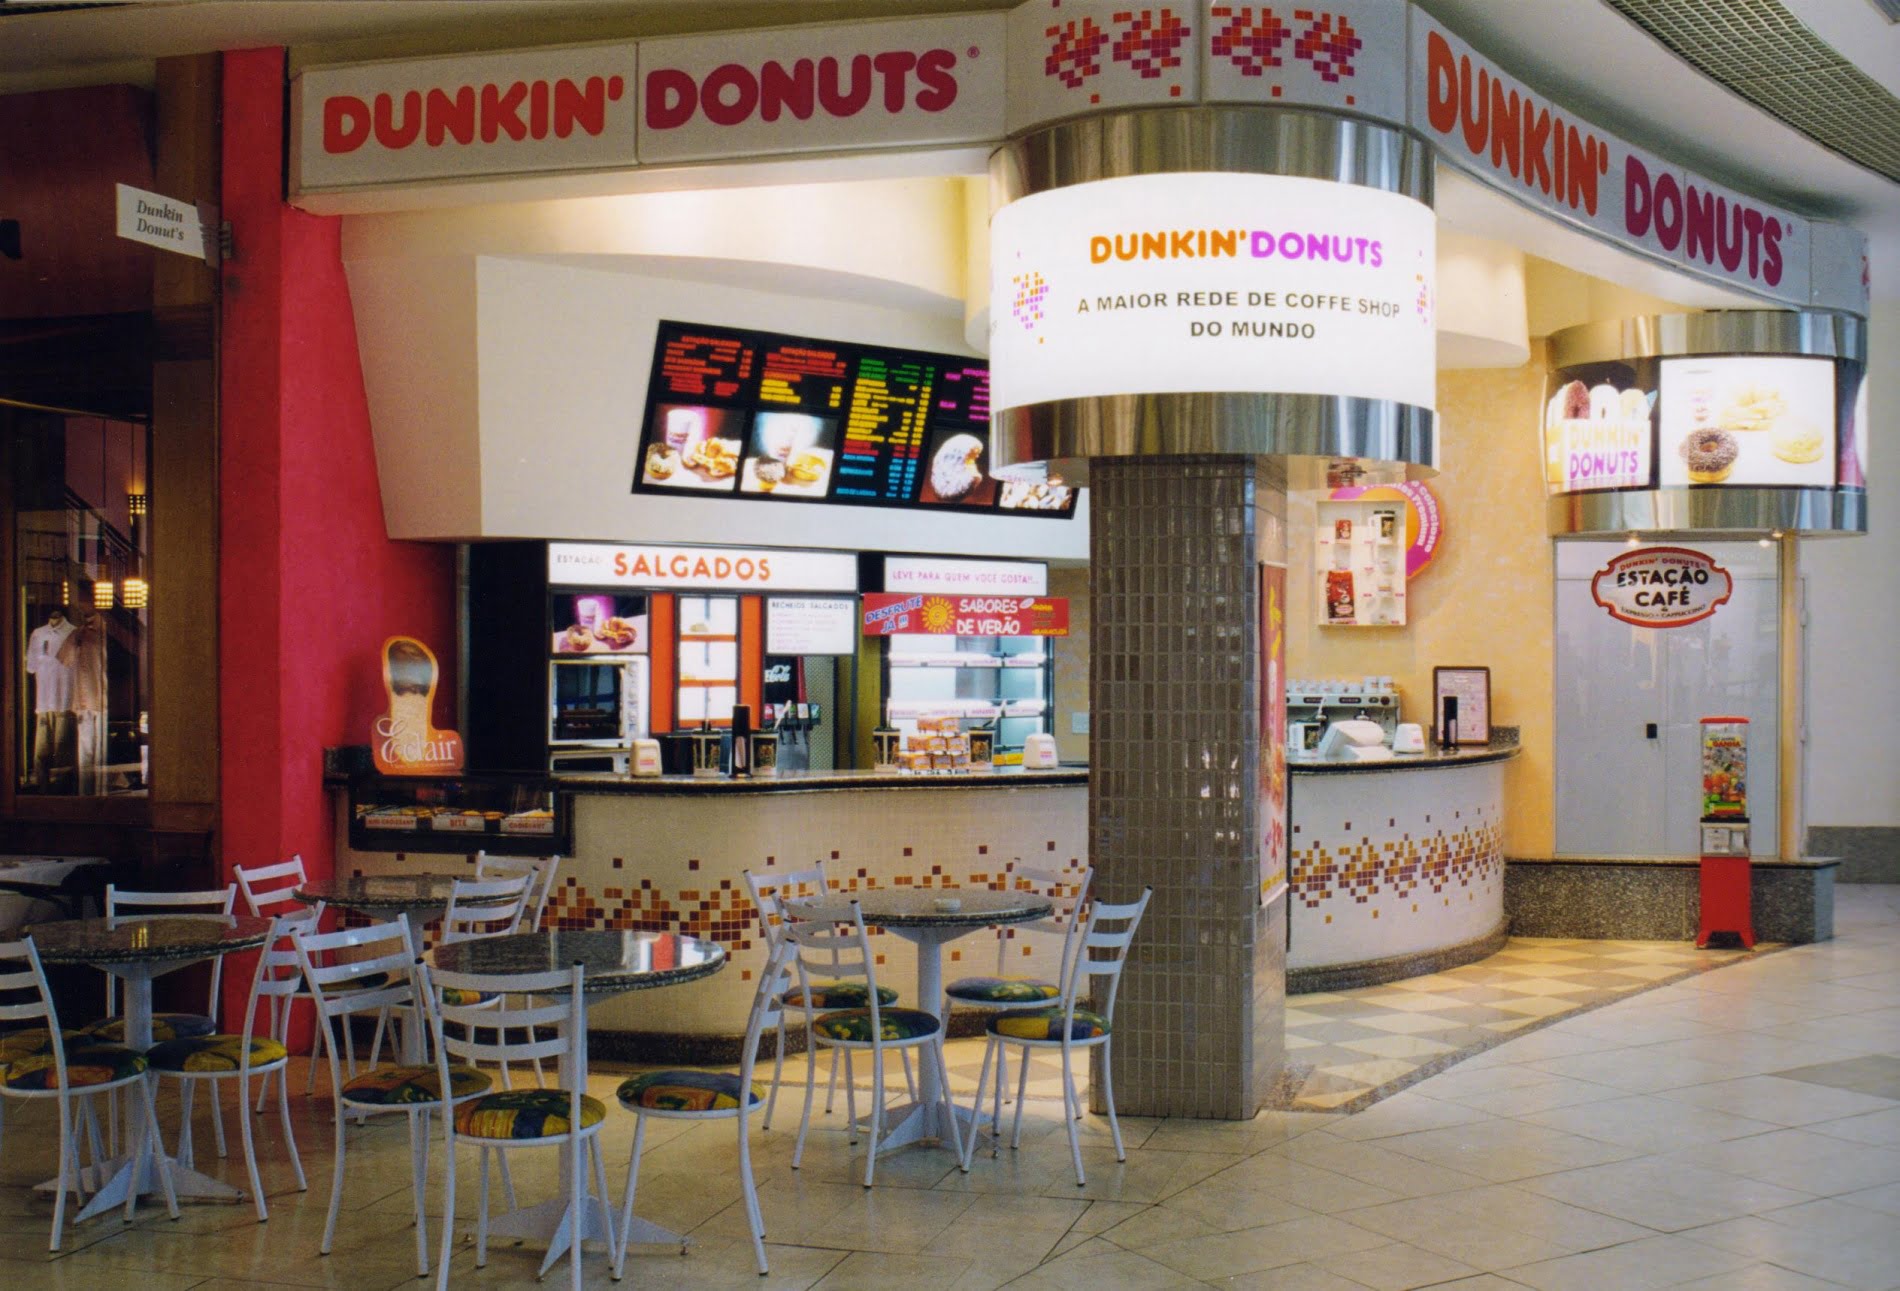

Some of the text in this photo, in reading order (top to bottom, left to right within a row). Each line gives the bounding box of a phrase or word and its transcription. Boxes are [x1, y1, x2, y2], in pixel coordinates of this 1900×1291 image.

[323, 48, 958, 154] DUNKIN' DONUTS
[1428, 31, 1783, 287] DUNKIN' DONUTS
[136, 200, 183, 222] Dunkin
[136, 218, 185, 240] Donut's
[1078, 291, 1401, 318] A MAIOR REDE DE COFFE SHOP
[1190, 321, 1316, 339] DO MUNDO
[1569, 450, 1640, 480] DONUTS
[613, 552, 772, 581] SALGADOS
[1616, 566, 1710, 587] ESTAÇÃO
[958, 598, 1019, 614] SABORES
[1634, 586, 1691, 607] CAFÉ
[864, 595, 924, 625] DESFRUTE
[956, 619, 975, 635] DE
[976, 616, 1021, 635] VERÃO
